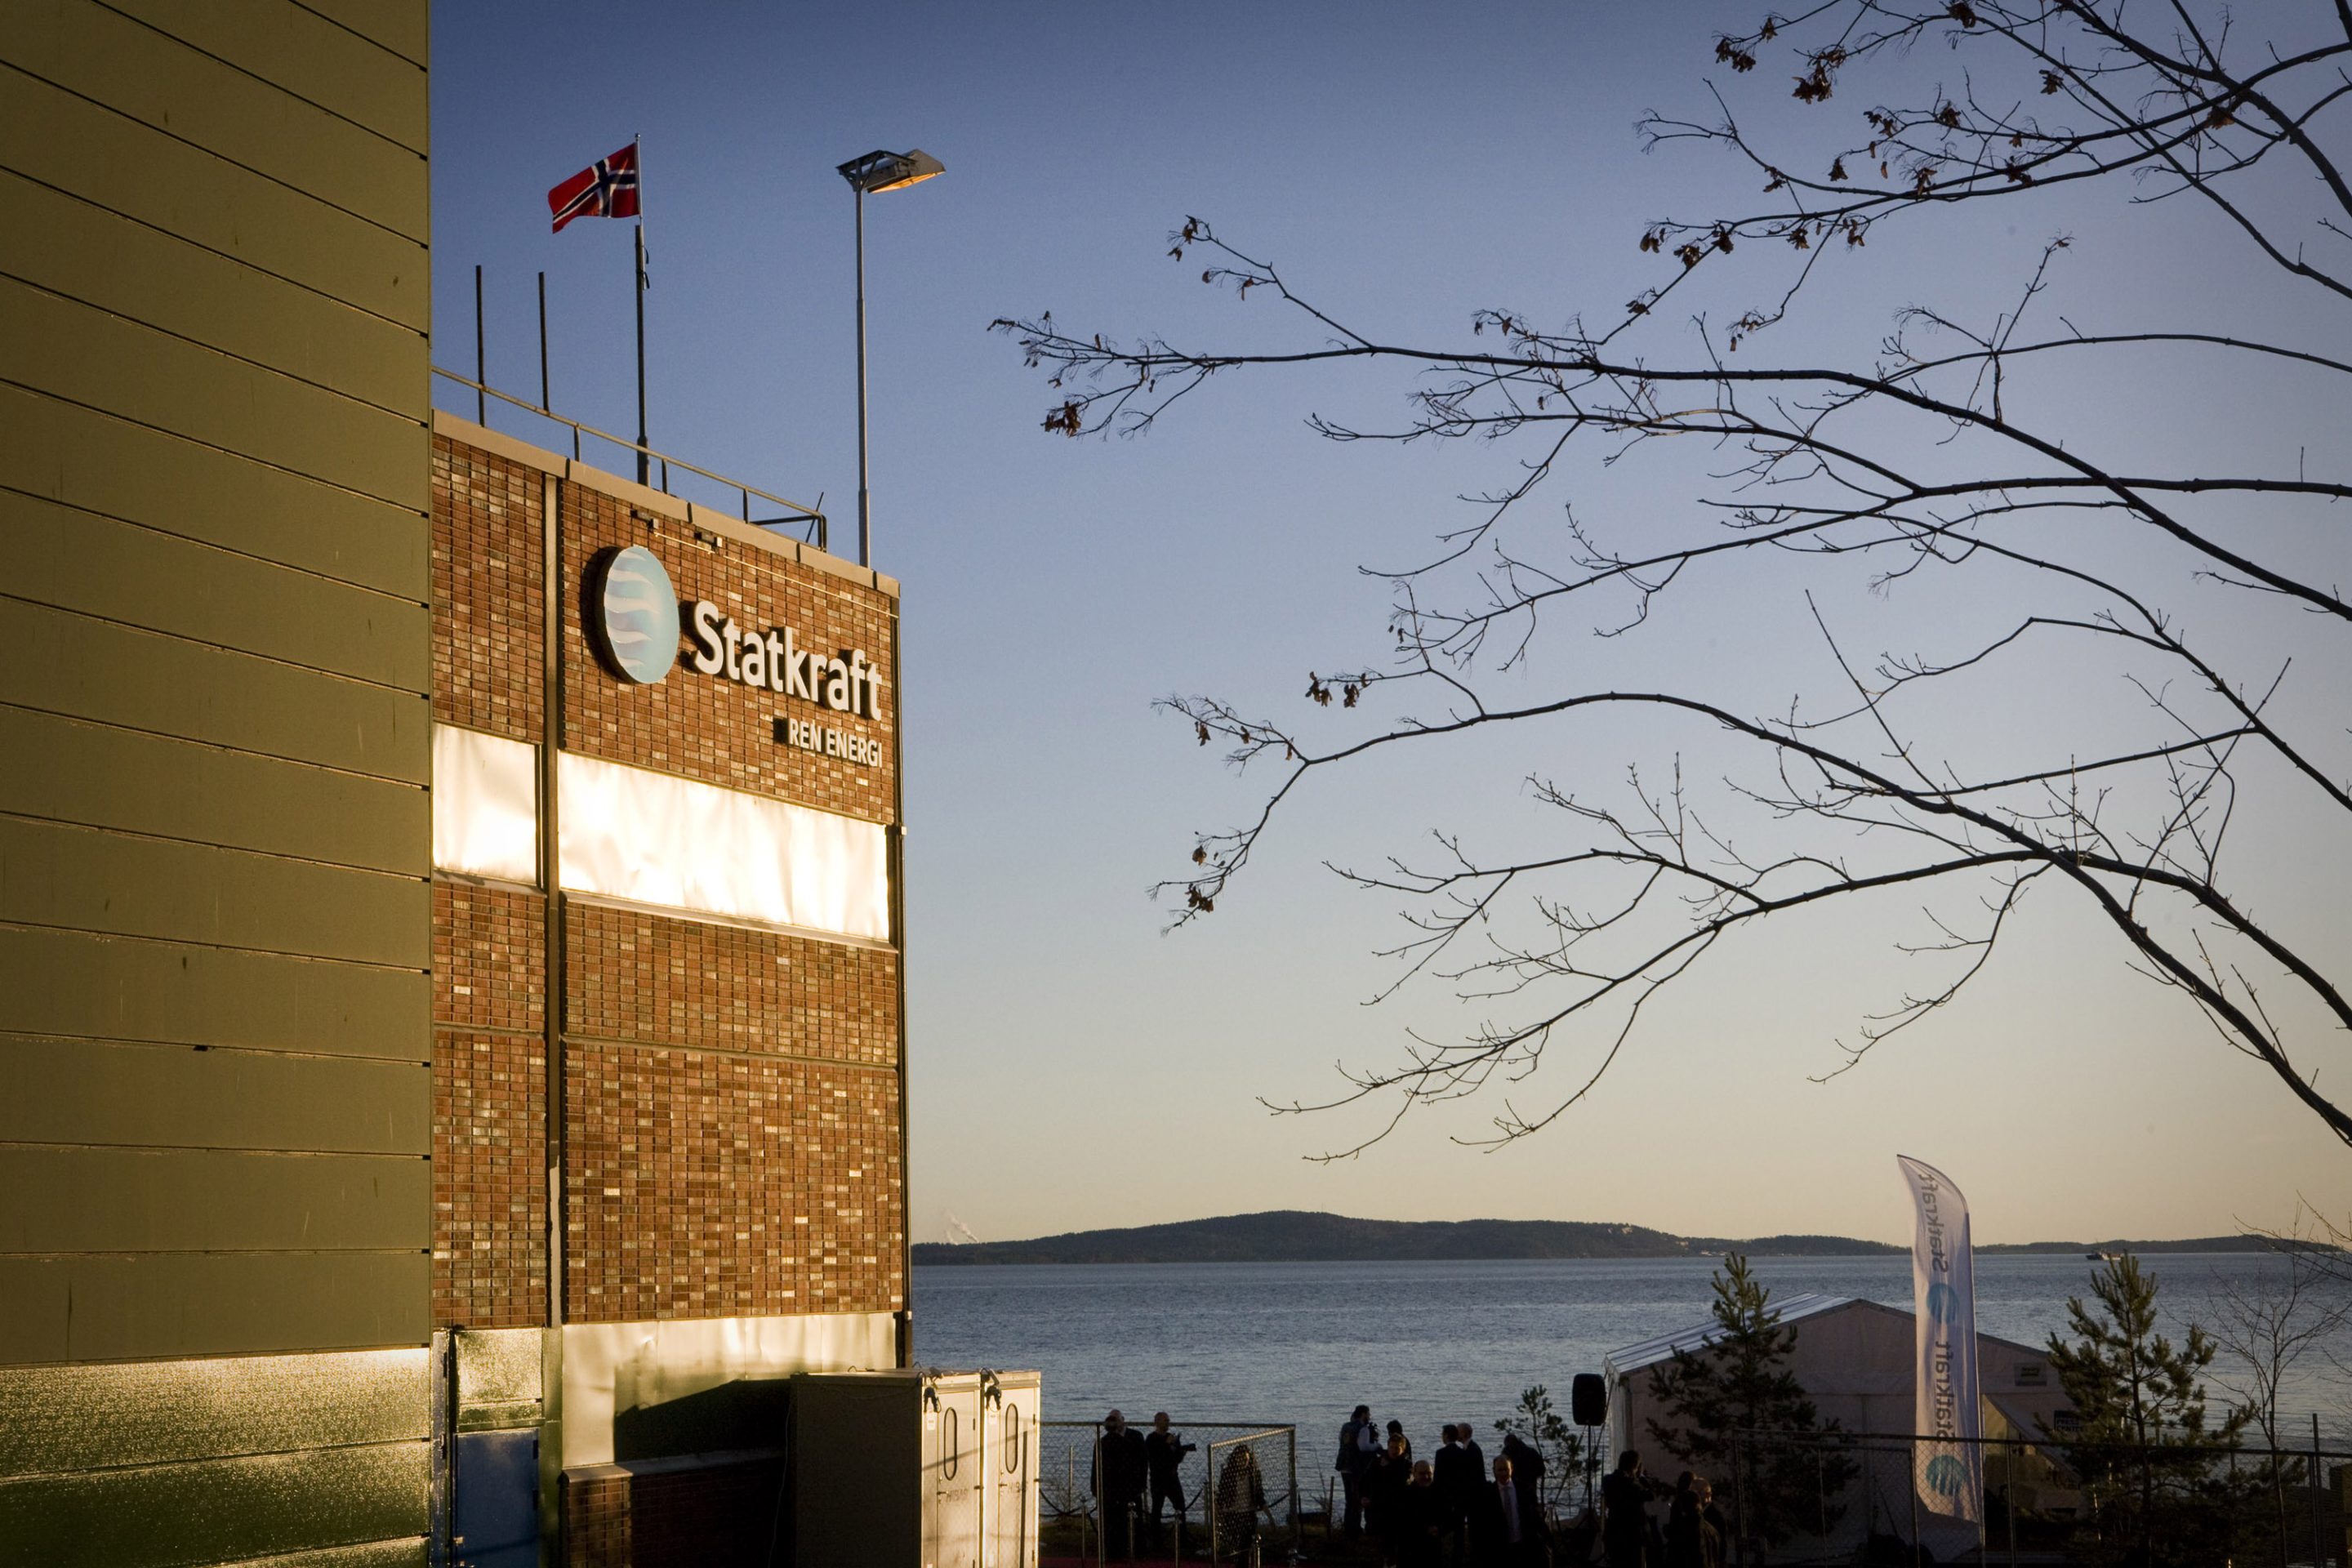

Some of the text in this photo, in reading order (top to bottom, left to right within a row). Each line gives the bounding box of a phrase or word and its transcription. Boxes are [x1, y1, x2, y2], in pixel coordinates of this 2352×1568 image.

[693, 600, 883, 722] Statkraft
[788, 717, 883, 768] REN ENERGI
